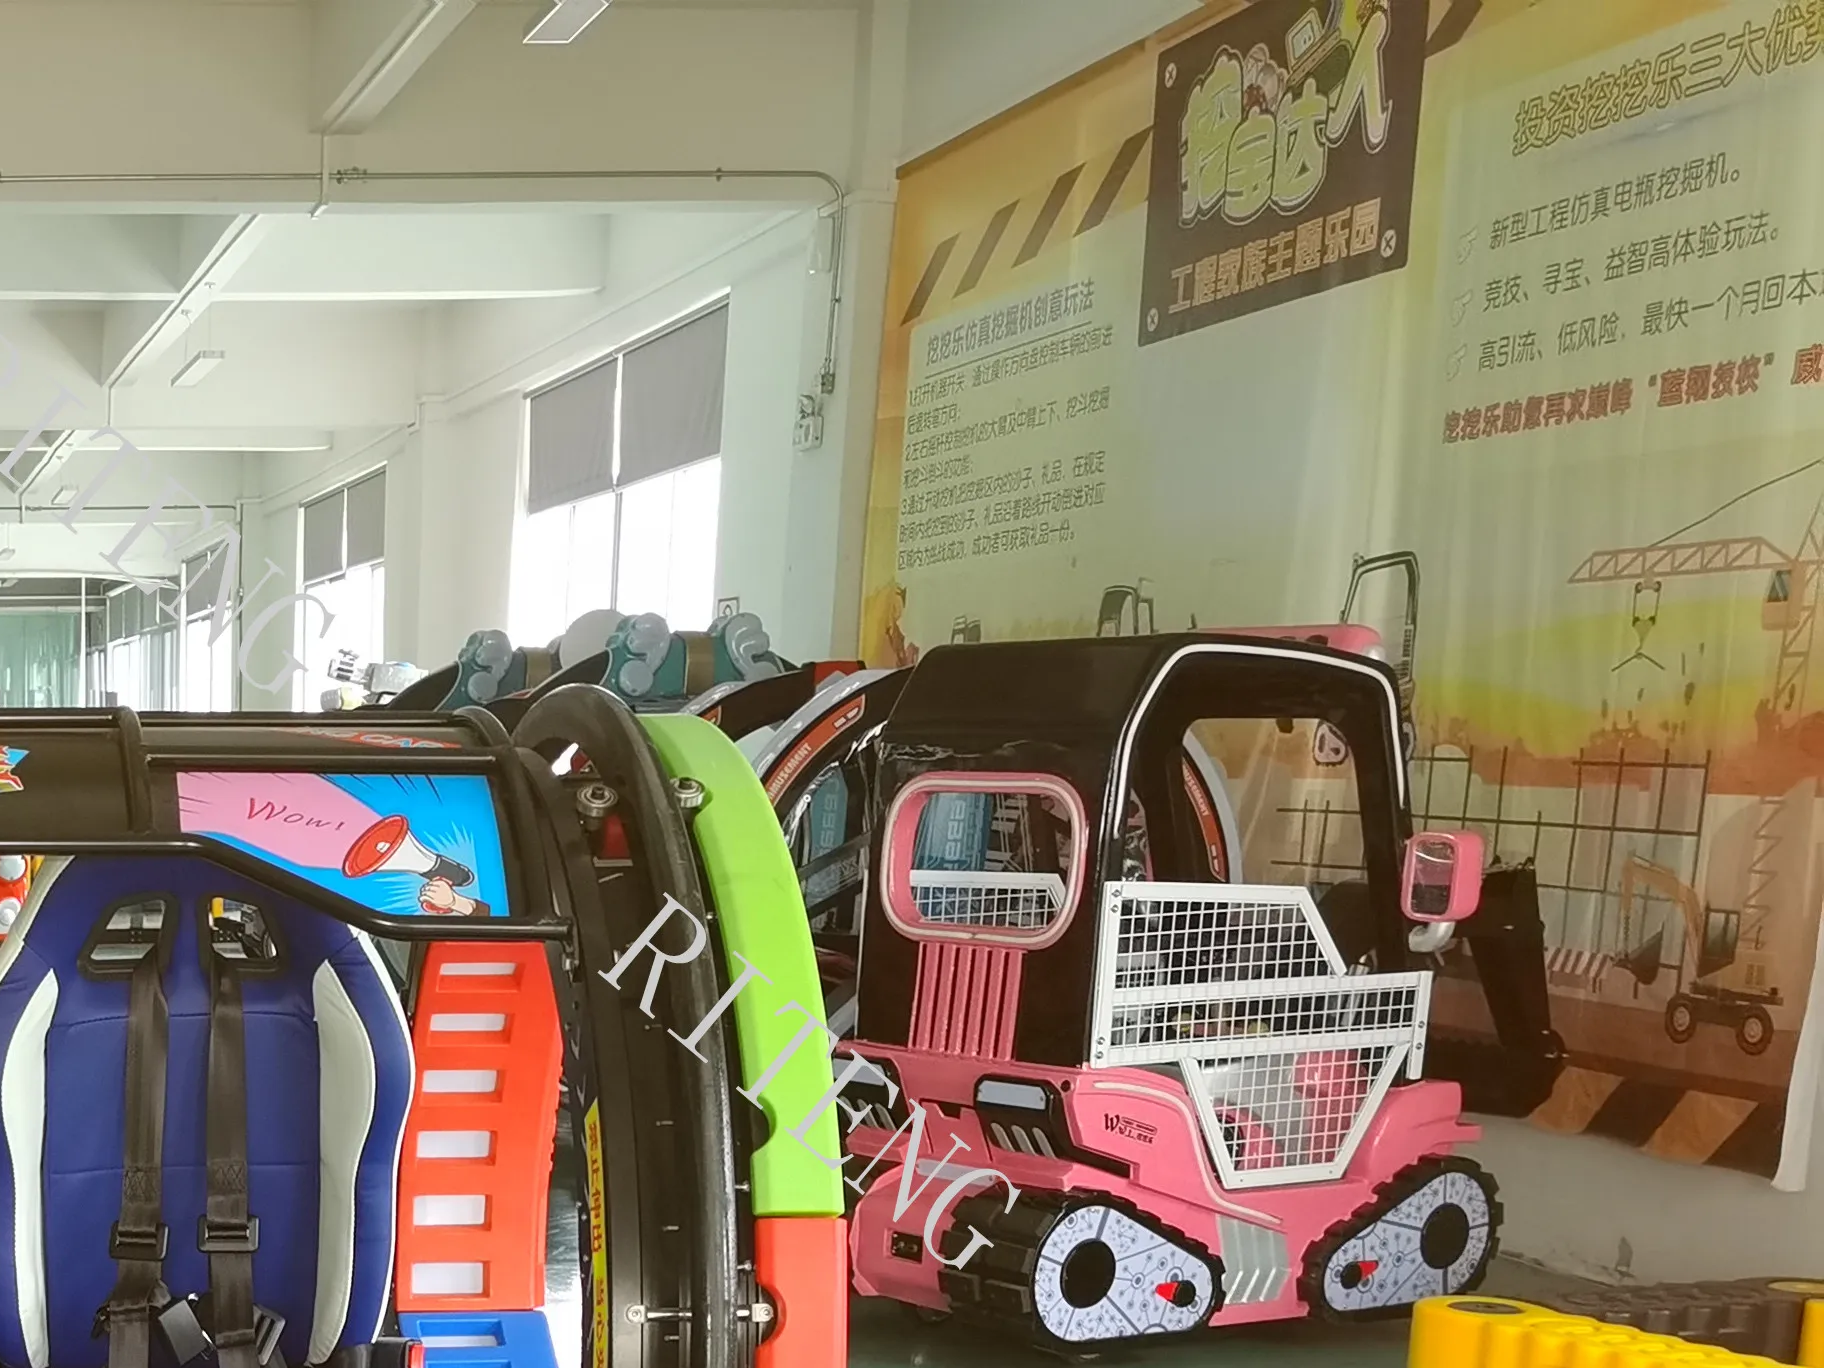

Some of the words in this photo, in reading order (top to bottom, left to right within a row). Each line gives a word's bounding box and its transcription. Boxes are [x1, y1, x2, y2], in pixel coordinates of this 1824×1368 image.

[1490, 152, 1740, 250] 新型工程仿真电瓶挖掘机。
[1168, 197, 1382, 314] 工程家族主题乐园
[1477, 268, 1824, 372] 高引流、低风险，最快一个月回本
